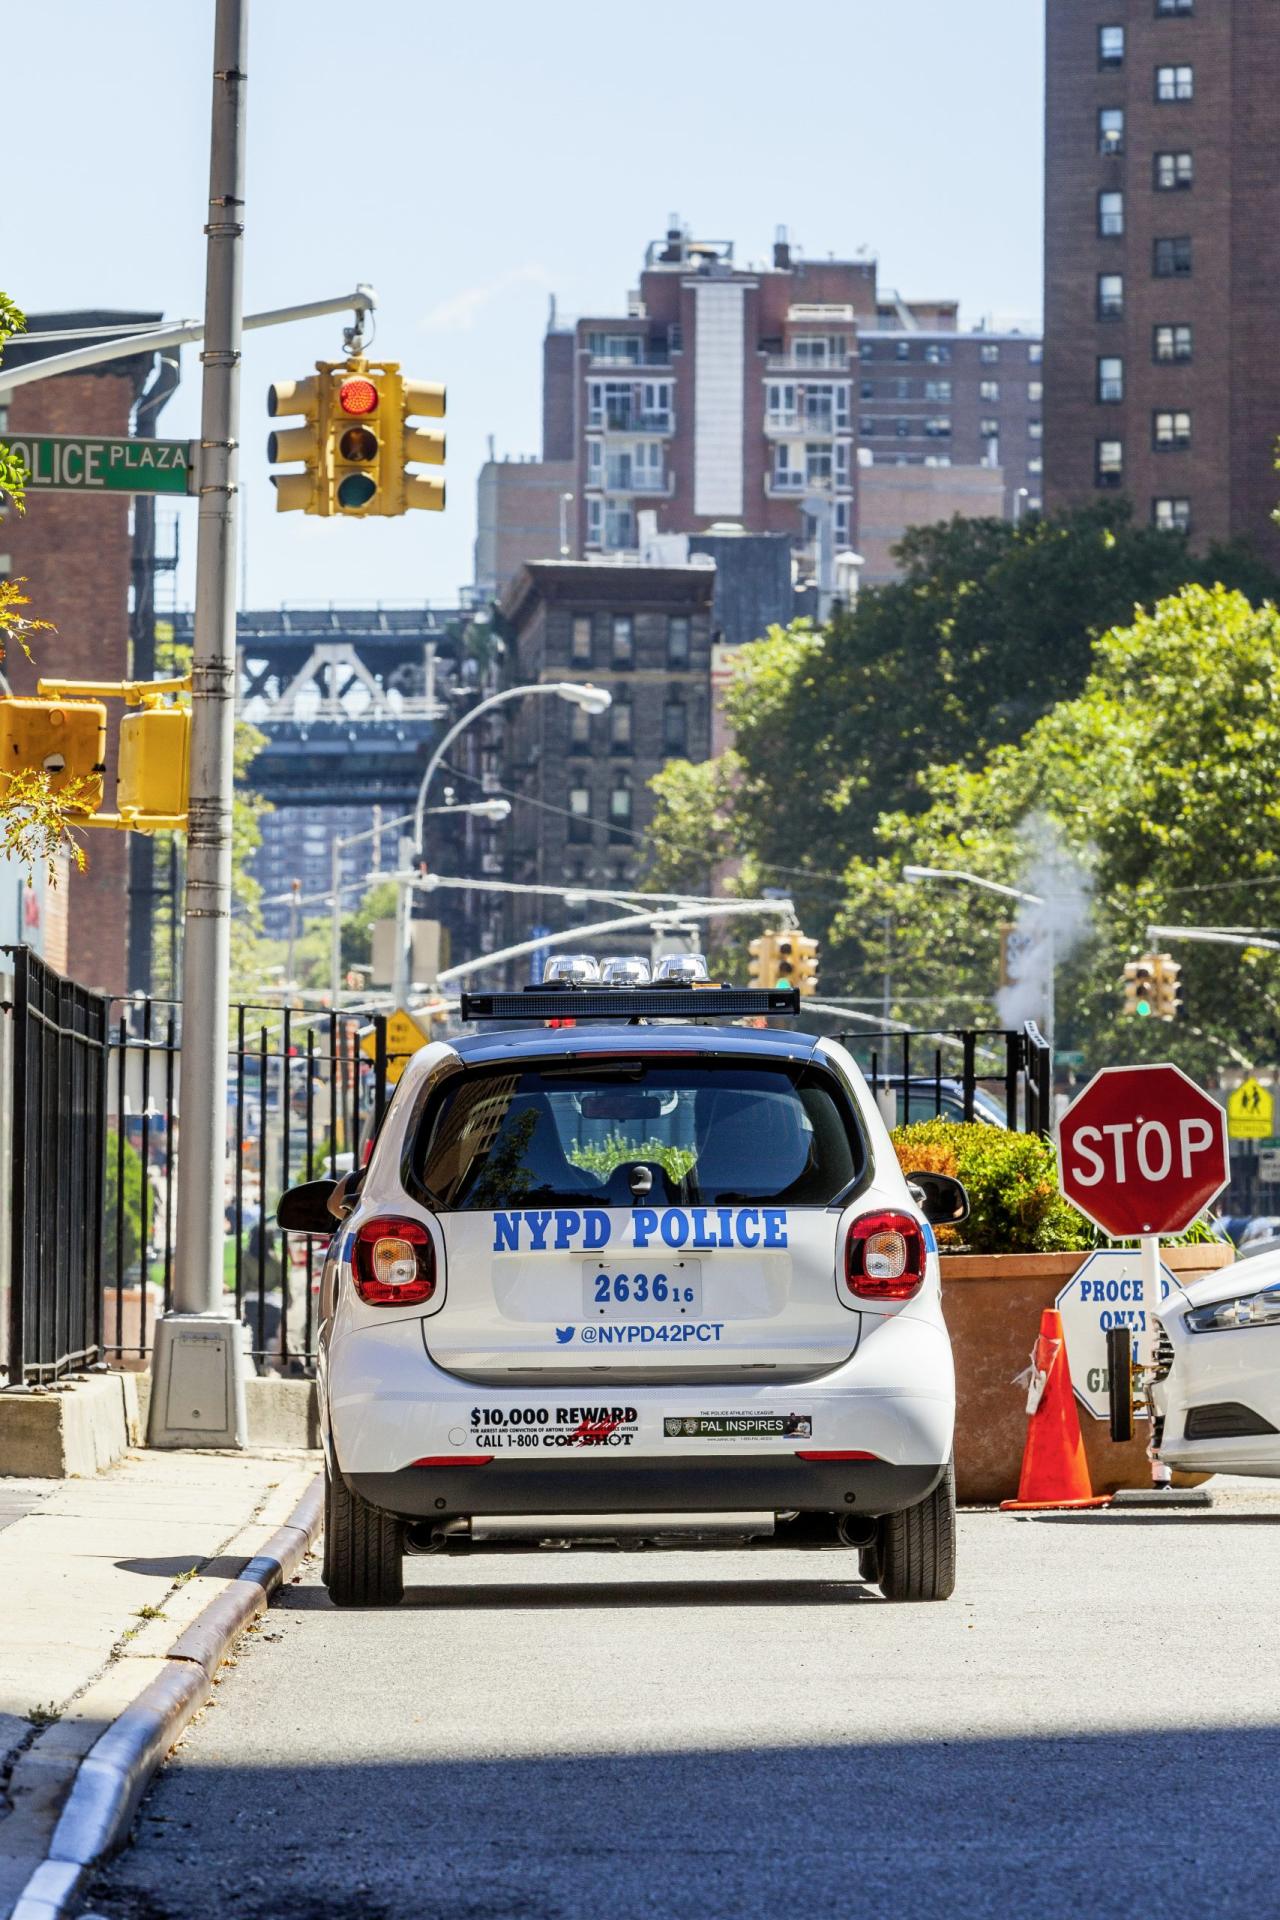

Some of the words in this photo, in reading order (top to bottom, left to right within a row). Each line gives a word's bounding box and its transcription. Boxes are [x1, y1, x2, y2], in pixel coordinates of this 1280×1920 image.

[9, 441, 105, 485] OLICE
[110, 445, 187, 469] PLAZA
[1072, 1118, 1213, 1187] STOP
[493, 1210, 611, 1251] NYPD
[632, 1208, 788, 1248] POLICE
[594, 1274, 669, 1302] 2636
[673, 1287, 694, 1302] 16
[1080, 1280, 1170, 1302] PROCED
[581, 1323, 724, 1344] @NYPD42PCT
[471, 1407, 549, 1427] $10,000
[556, 1407, 638, 1425] REWARD
[700, 1421, 723, 1432] PAL
[726, 1420, 784, 1431] INSPIRES
[476, 1435, 503, 1447] CALL
[508, 1434, 539, 1447] 1-800
